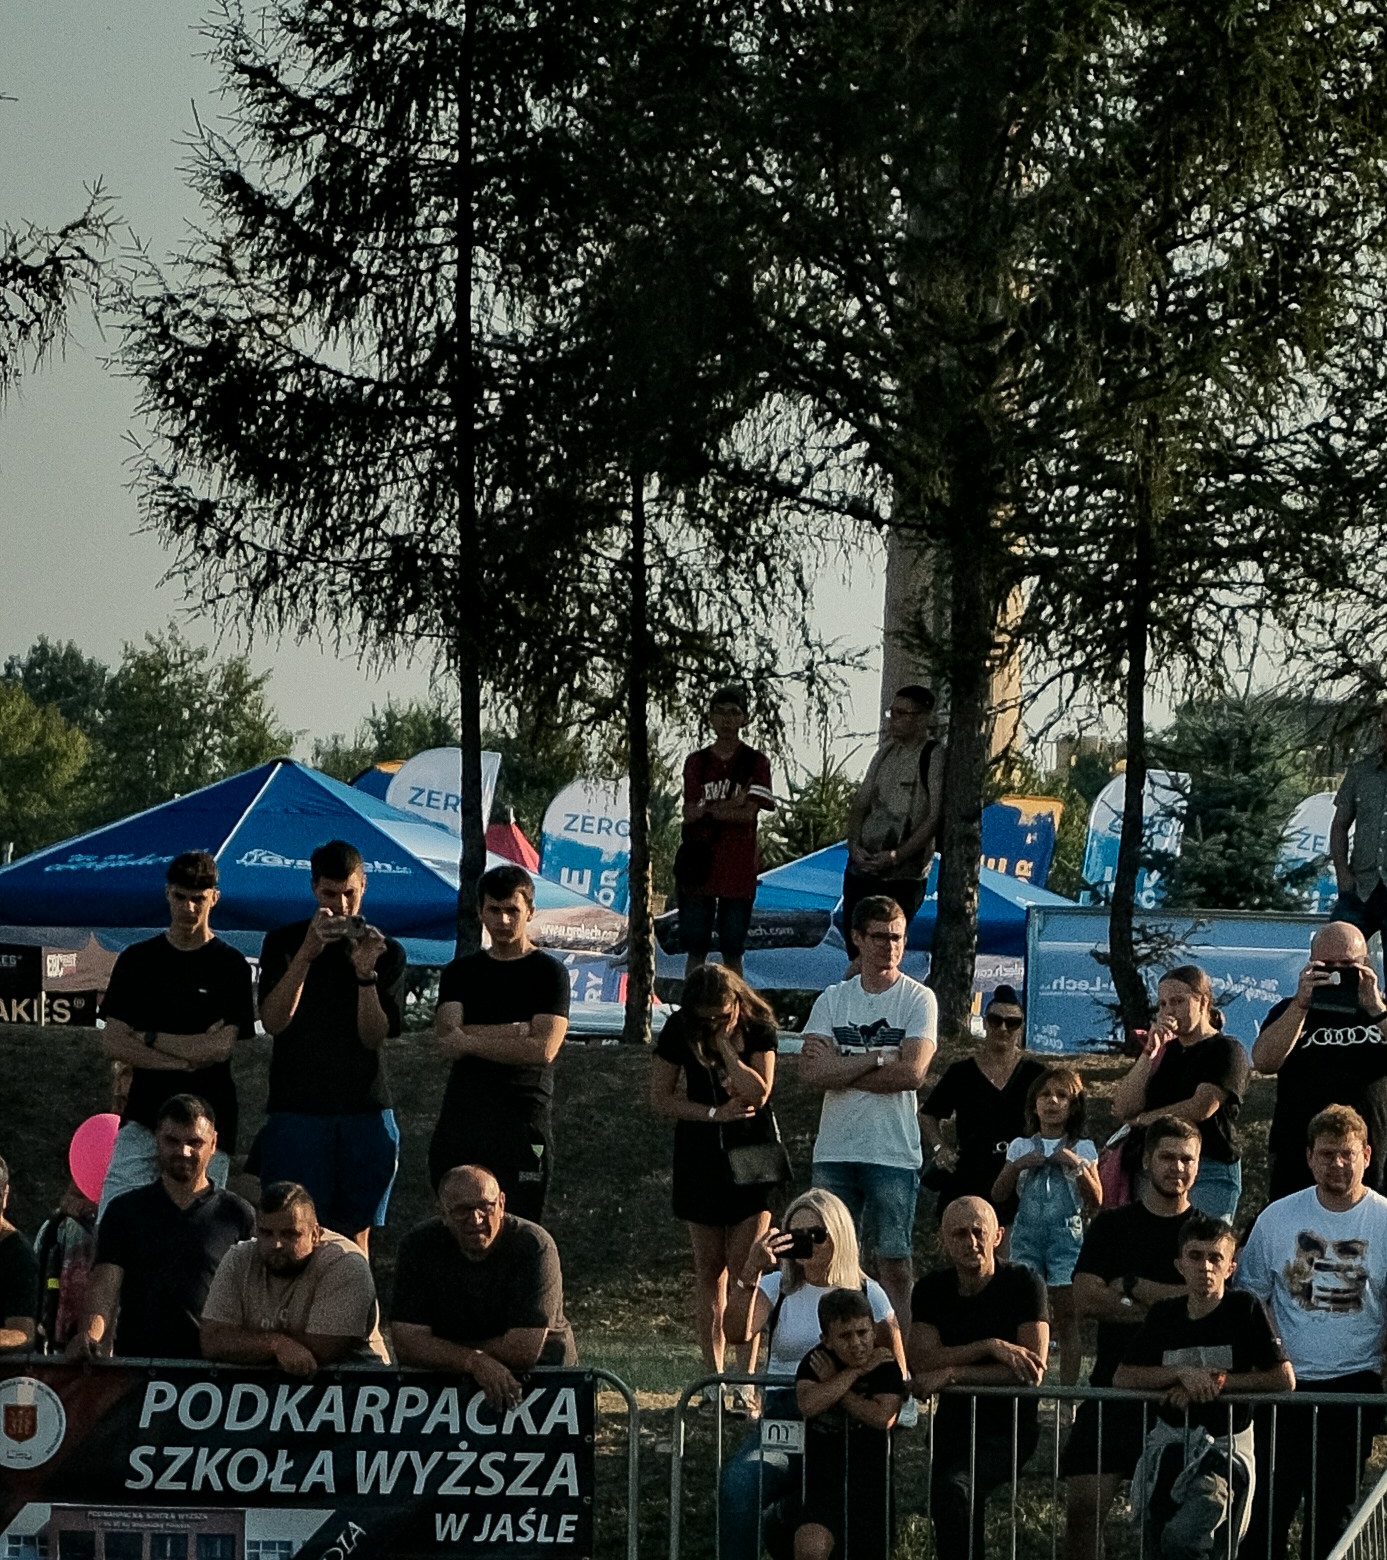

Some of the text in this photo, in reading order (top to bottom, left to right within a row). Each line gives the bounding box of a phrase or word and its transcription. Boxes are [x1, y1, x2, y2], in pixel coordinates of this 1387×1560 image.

[138, 1380, 580, 1436] PODKARPACKA
[124, 1440, 580, 1498] SZKOŁA WYŻSZA
[434, 1507, 579, 1544] W JAŚLE
